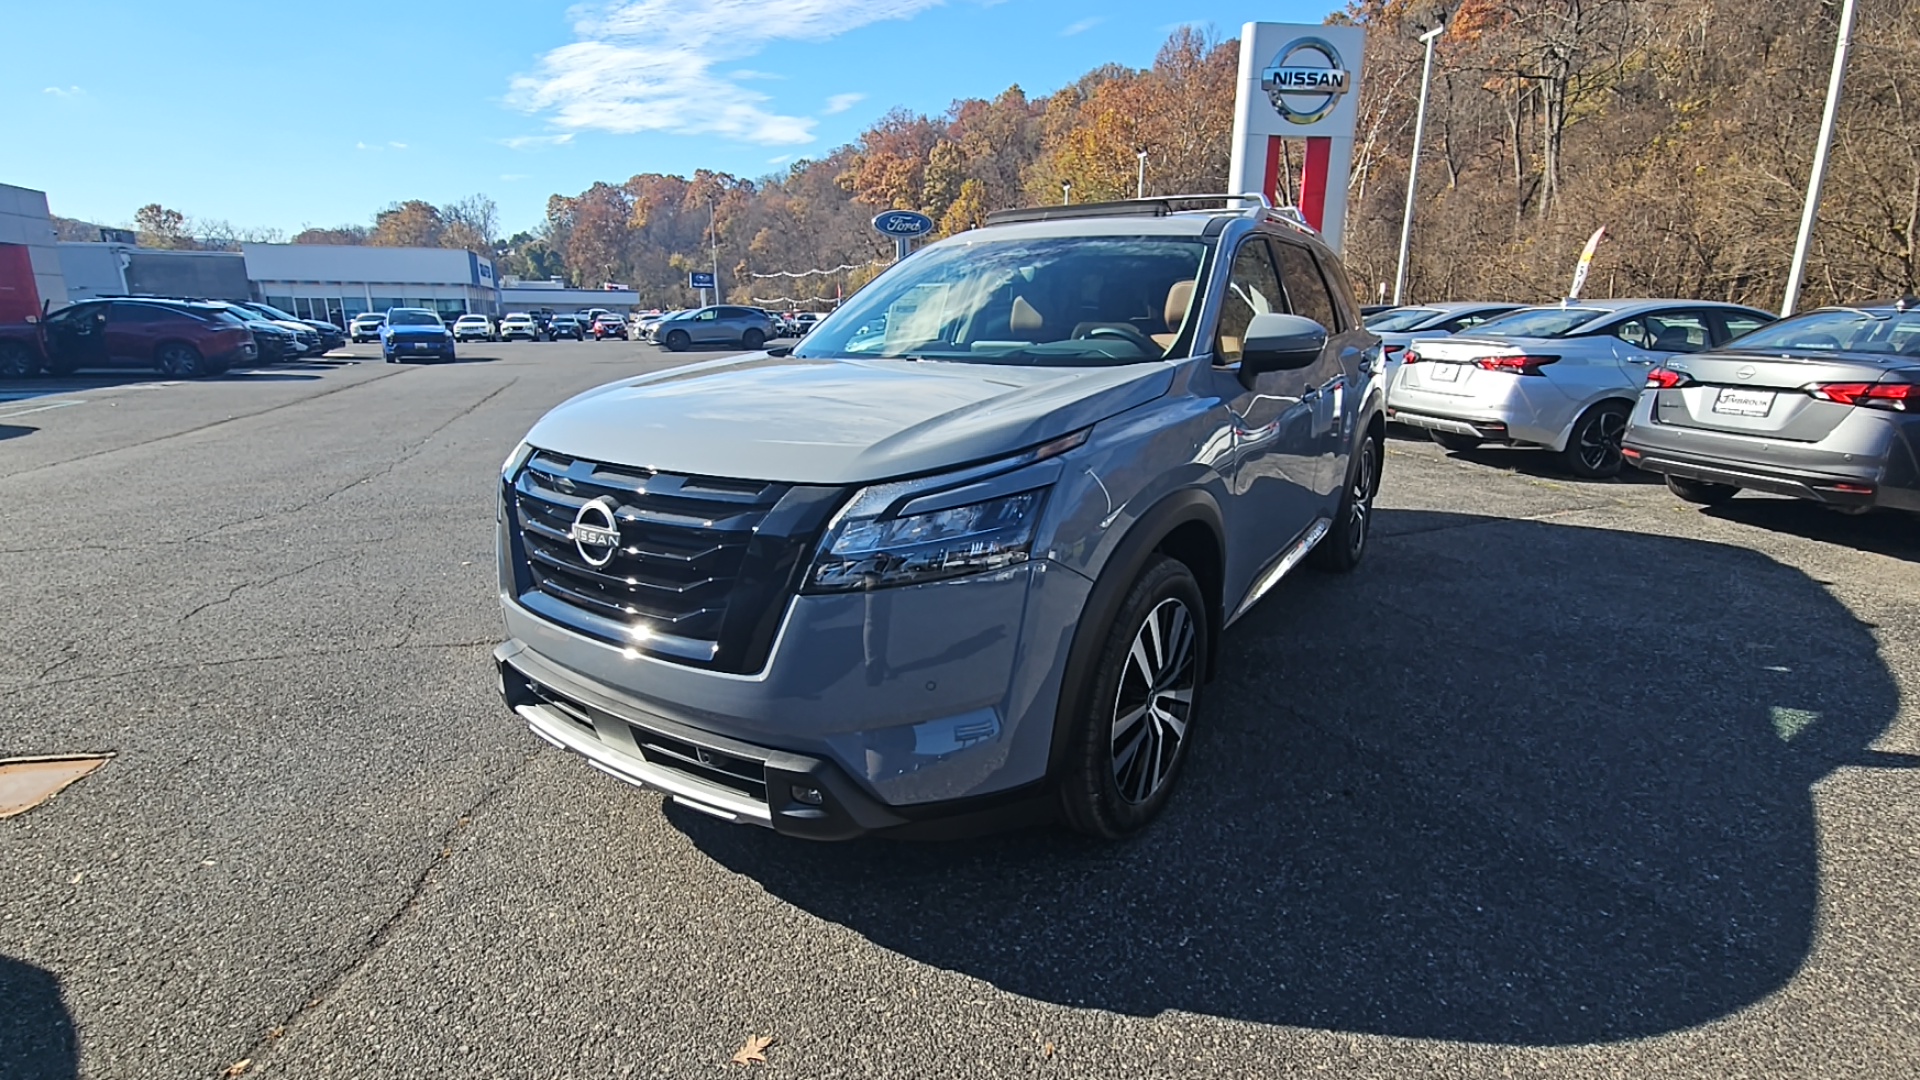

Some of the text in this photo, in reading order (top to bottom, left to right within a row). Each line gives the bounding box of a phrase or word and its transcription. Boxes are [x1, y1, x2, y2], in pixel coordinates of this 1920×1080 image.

[1273, 71, 1344, 87] NISSAN
[887, 216, 921, 231] Ford
[574, 528, 619, 546] NISSAN
